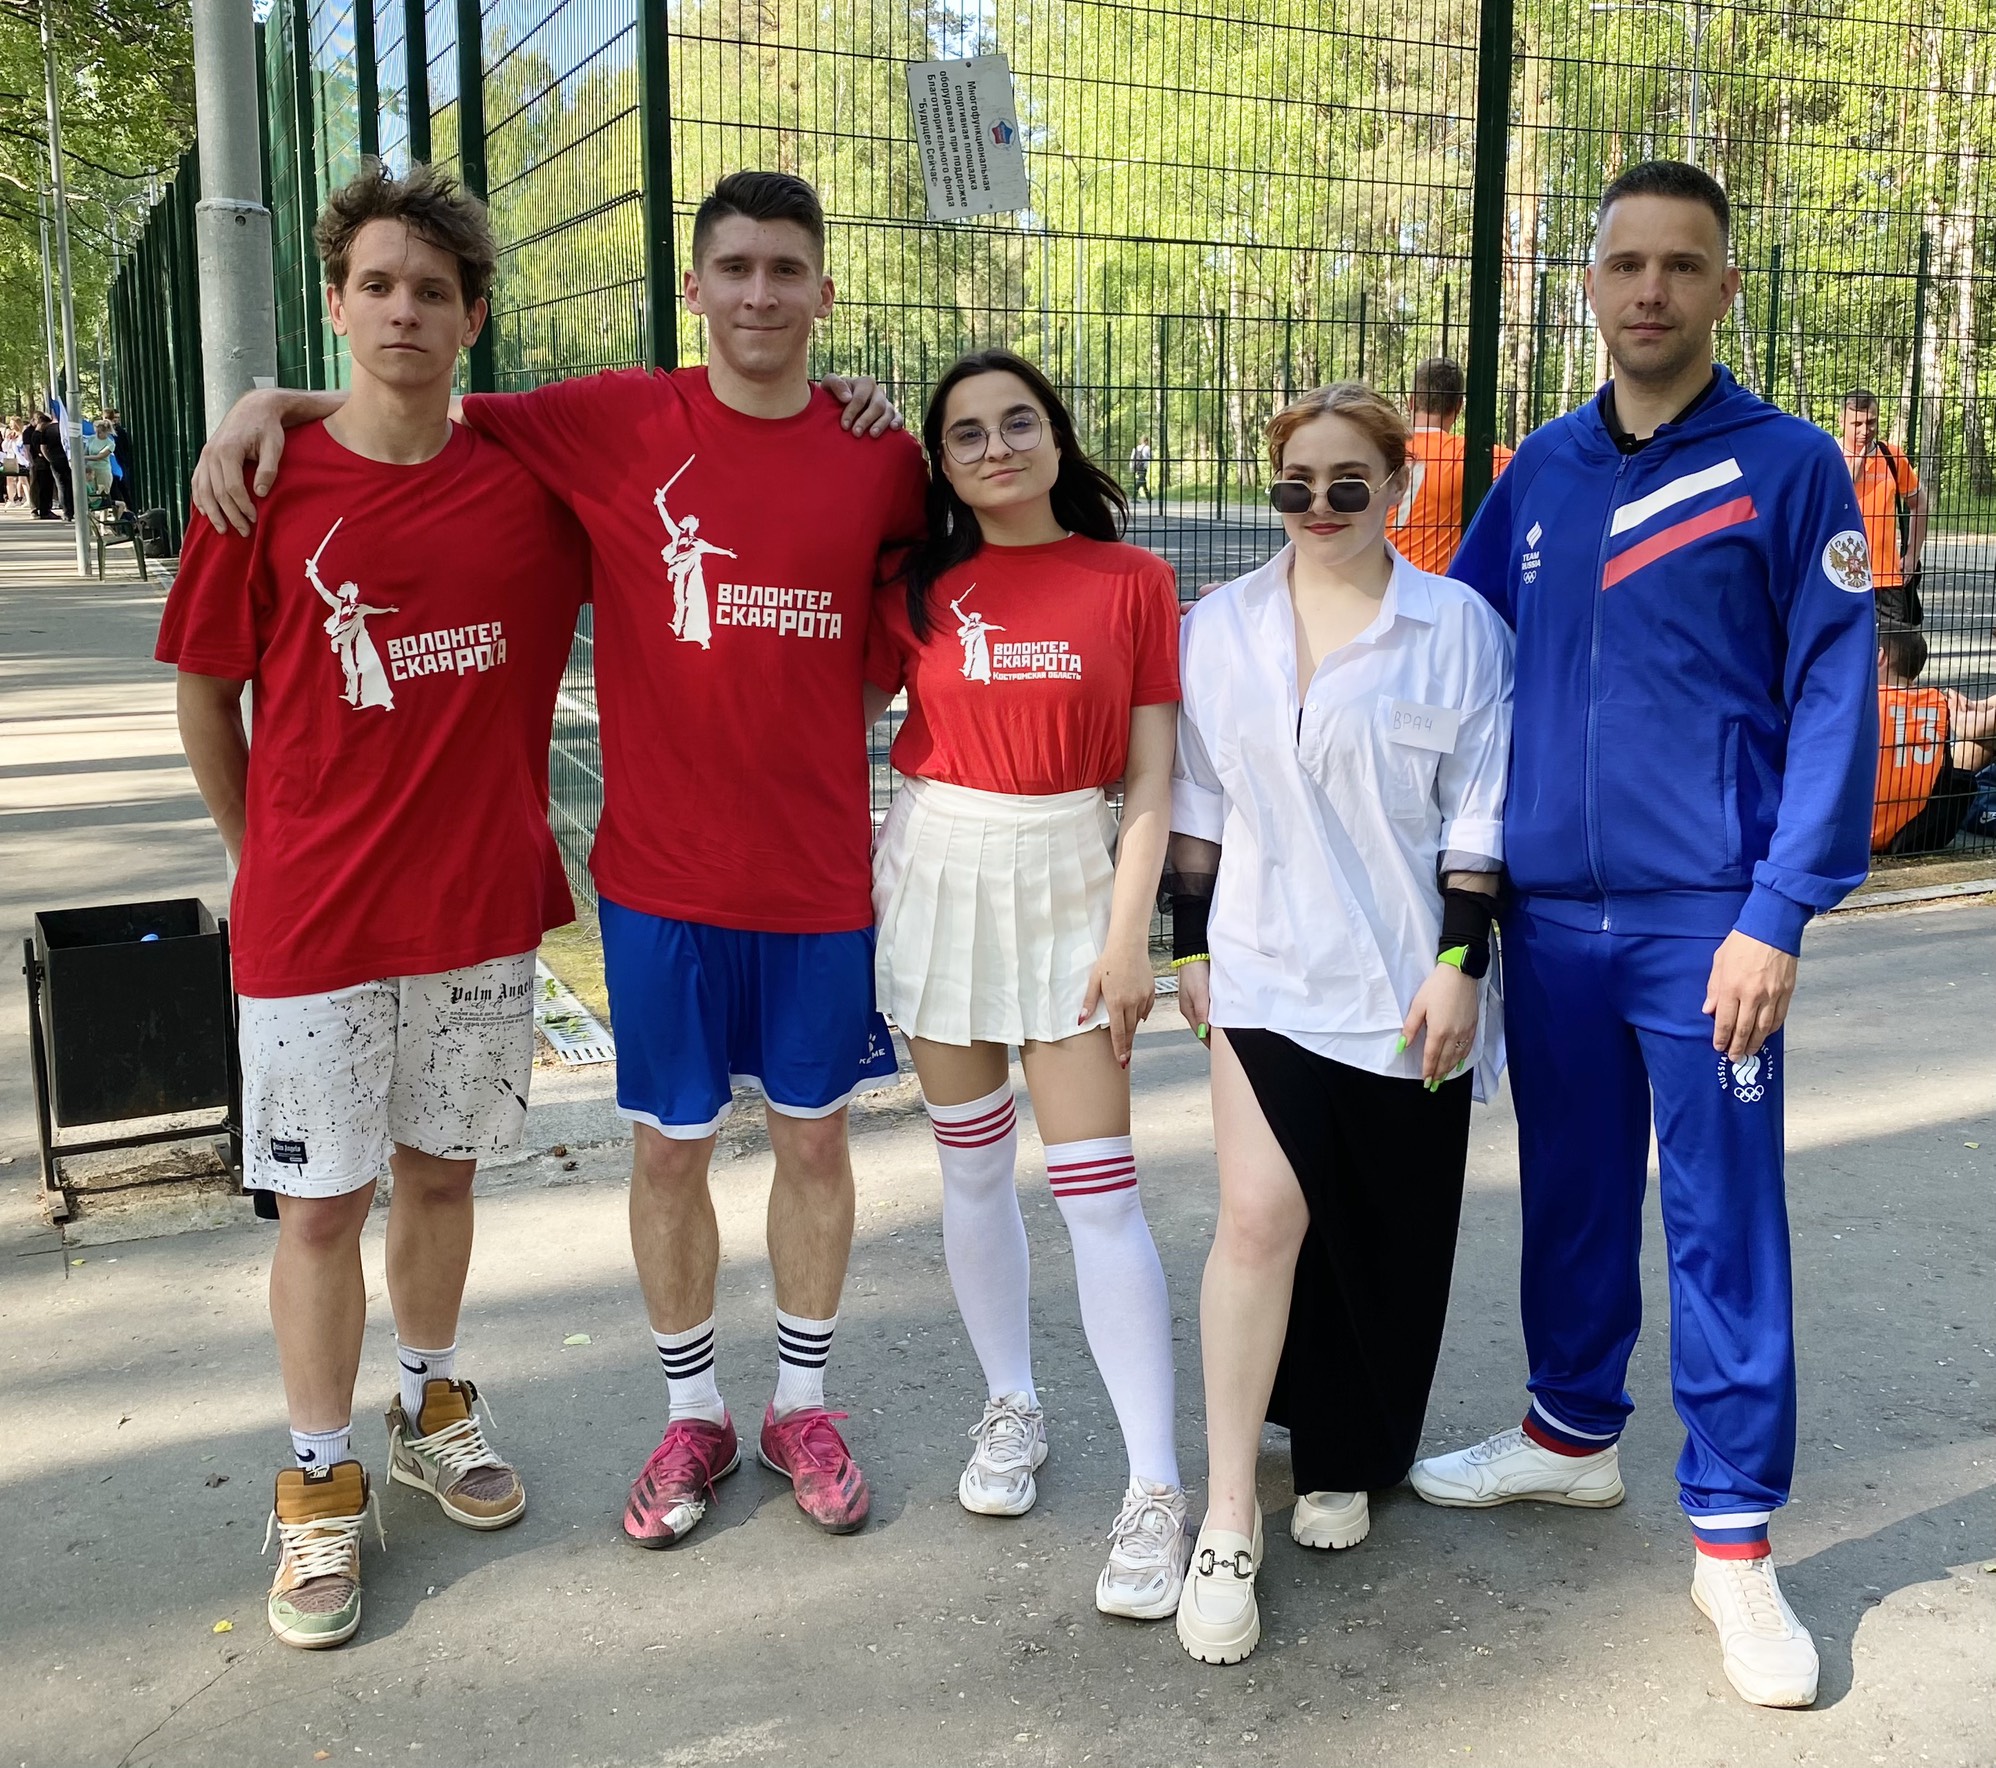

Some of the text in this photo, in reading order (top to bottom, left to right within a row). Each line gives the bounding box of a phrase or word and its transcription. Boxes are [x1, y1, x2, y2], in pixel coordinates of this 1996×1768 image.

[928, 74, 955, 207] Благотворительного фонда
[940, 70, 968, 207] оборудована при поддержке
[955, 85, 978, 190] спортивная площадка
[967, 81, 990, 191] Многофункциональная
[1522, 551, 1540, 562] TEAM
[717, 583, 833, 611] ВОЛОНТЕР
[387, 621, 502, 660] ВОЛОНТЕР
[993, 641, 1069, 655] ВОЛОНТЕР
[1889, 705, 1939, 768] 13
[450, 985, 492, 1004] Palm
[1717, 1052, 1728, 1090] RUSSIA
